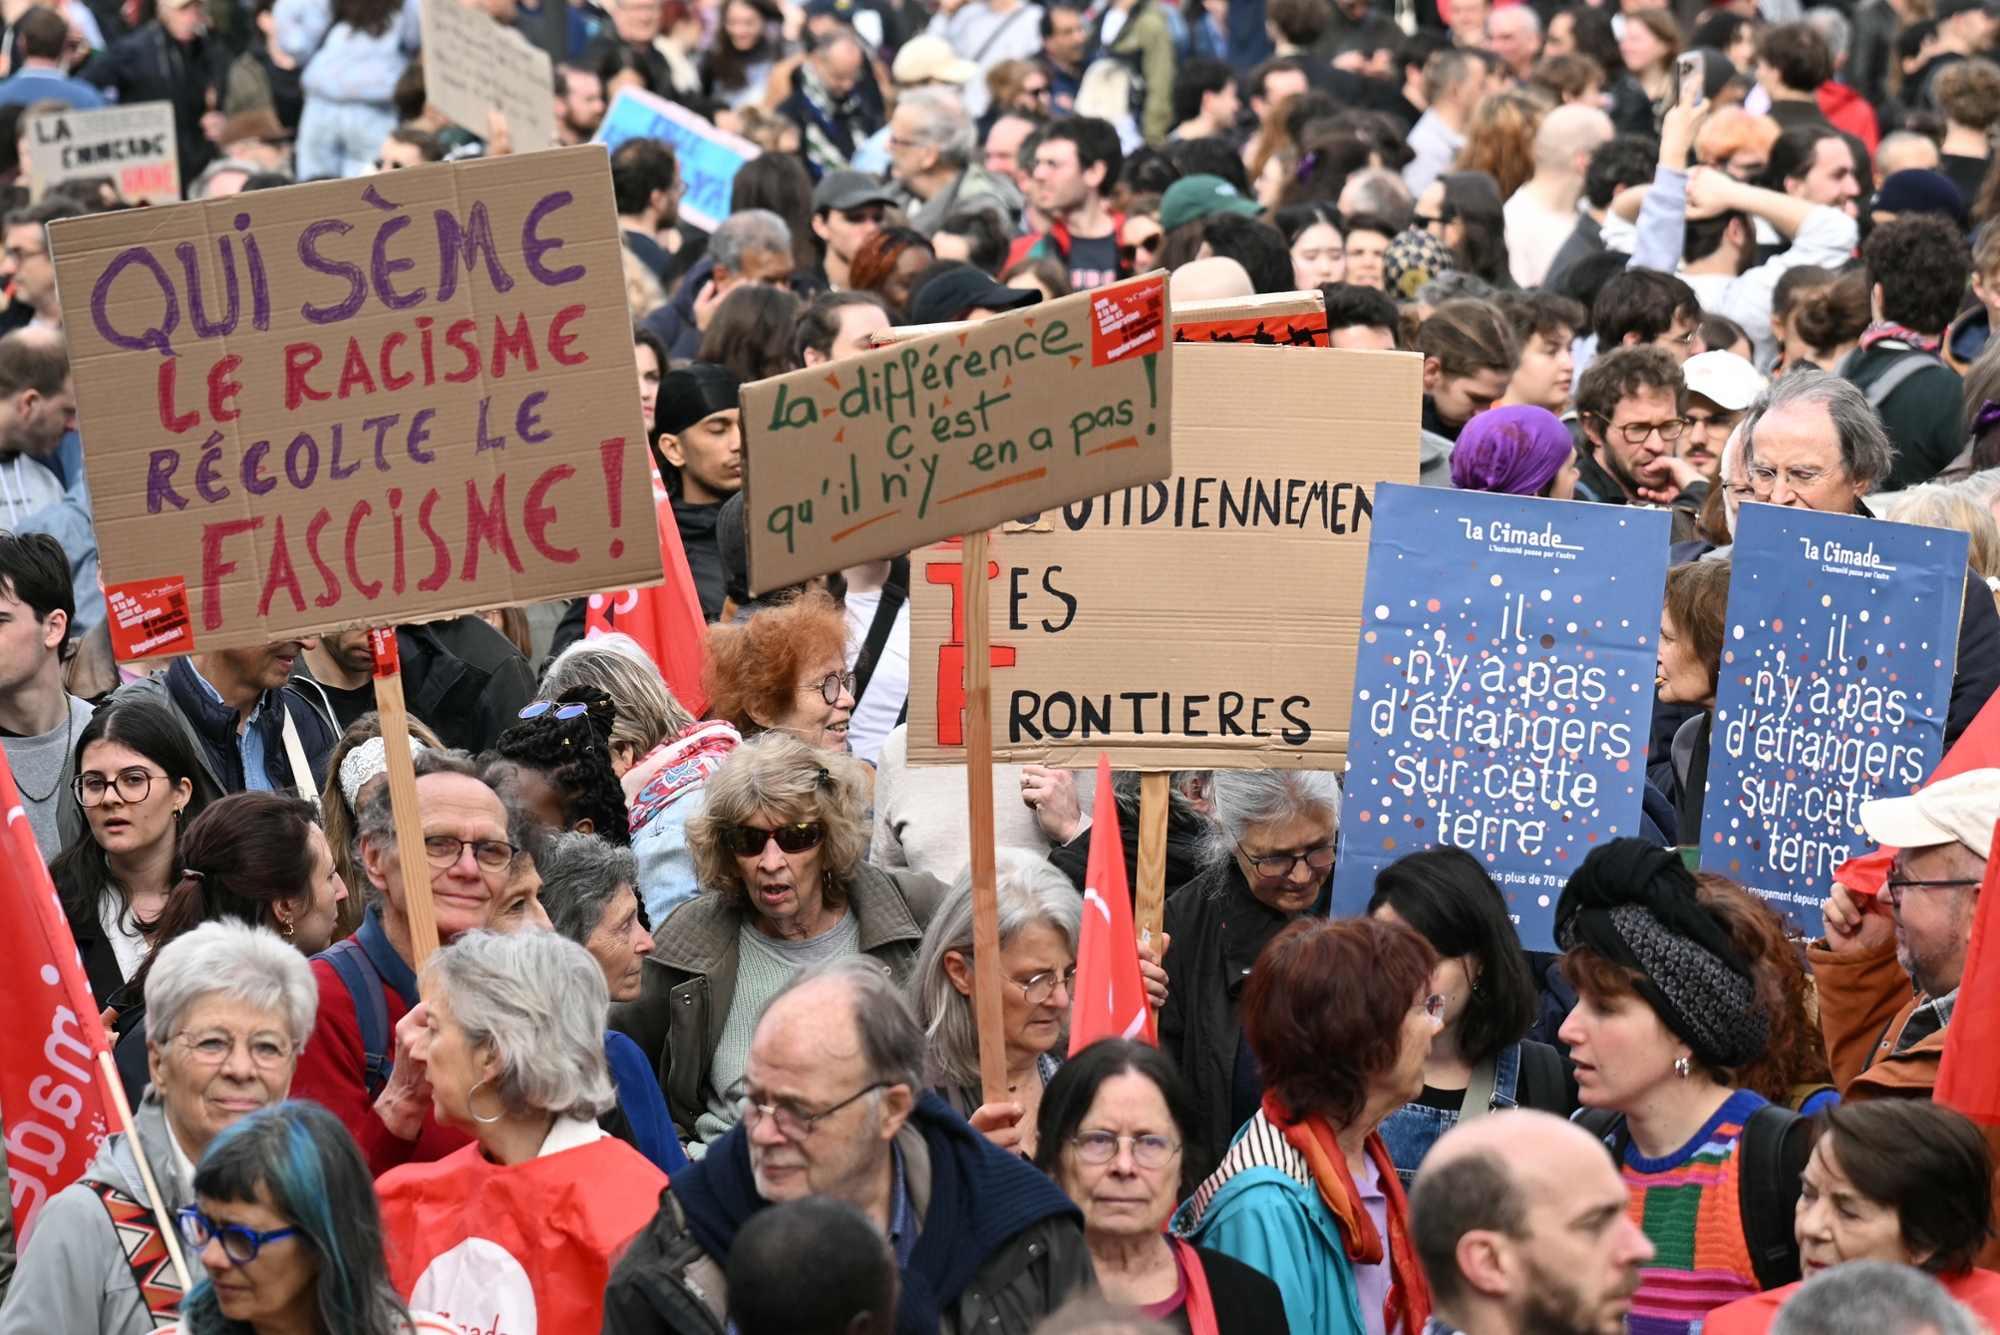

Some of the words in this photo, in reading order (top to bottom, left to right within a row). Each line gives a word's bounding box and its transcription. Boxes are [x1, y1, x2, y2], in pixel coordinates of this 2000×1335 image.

[35, 118, 71, 144] LA
[298, 184, 586, 324] SÈME
[1100, 311, 1141, 336] immigration
[158, 355, 242, 431] LE
[840, 320, 1083, 423] différence
[147, 407, 436, 514] RÉCOLTE
[476, 390, 553, 455] LE
[768, 454, 859, 554] qu'il
[881, 454, 939, 520] n'y
[969, 438, 1018, 471] en
[1028, 427, 1053, 451] a
[1070, 399, 1134, 456] pas
[1458, 517, 1484, 541] la
[1490, 521, 1584, 551] Cimade
[1489, 544, 1523, 555] L'humanité
[1523, 549, 1542, 557] passe
[1555, 551, 1576, 560] l'autre
[1799, 537, 1819, 560] la
[1824, 541, 1897, 571] Cimade
[120, 607, 162, 630] immigration
[1501, 592, 1526, 642] il
[1827, 613, 1847, 663] il
[1406, 634, 1468, 701] n'y
[1480, 655, 1506, 694] a
[1524, 661, 1606, 709] pas
[1754, 661, 1801, 721] n'y
[1809, 677, 1830, 715] a
[1838, 683, 1908, 731] pas
[1370, 686, 1631, 763] d'étrangers
[1726, 708, 1924, 786] d'étrangers
[1392, 755, 1468, 794] sur
[1484, 757, 1597, 808] cette
[1739, 776, 1796, 816] sur
[1804, 780, 1874, 829] cett
[1437, 799, 1545, 856] terre
[1504, 871, 1526, 884] plus
[1528, 873, 1541, 885] de
[1543, 875, 1555, 886] 70
[1748, 887, 1792, 901] engagement
[1792, 892, 1819, 906] depuis
